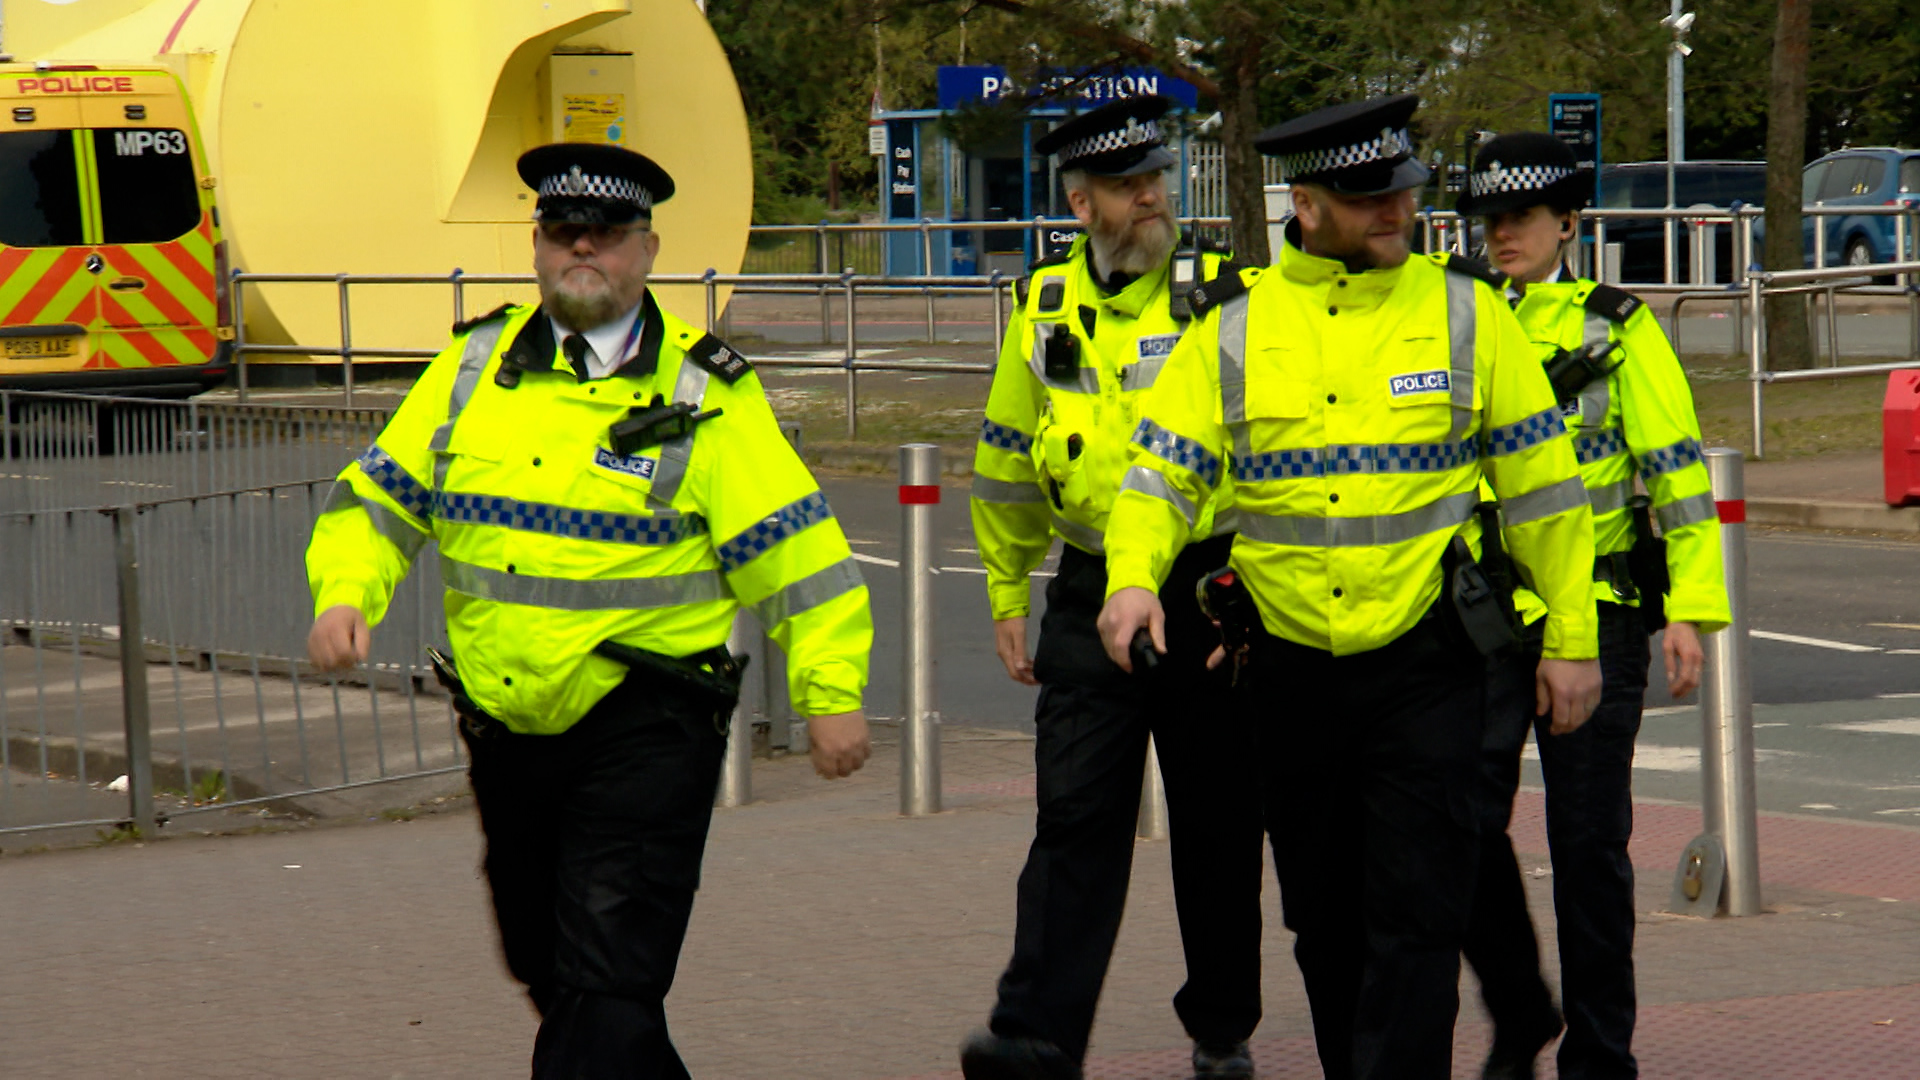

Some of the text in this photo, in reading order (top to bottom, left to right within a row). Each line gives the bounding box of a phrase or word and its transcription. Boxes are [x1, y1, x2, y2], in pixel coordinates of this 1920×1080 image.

[17, 77, 134, 94] POLICE
[982, 76, 1031, 98] PA
[114, 130, 186, 156] MP63
[1142, 339, 1177, 354] POLI
[1393, 373, 1448, 392] POLICE
